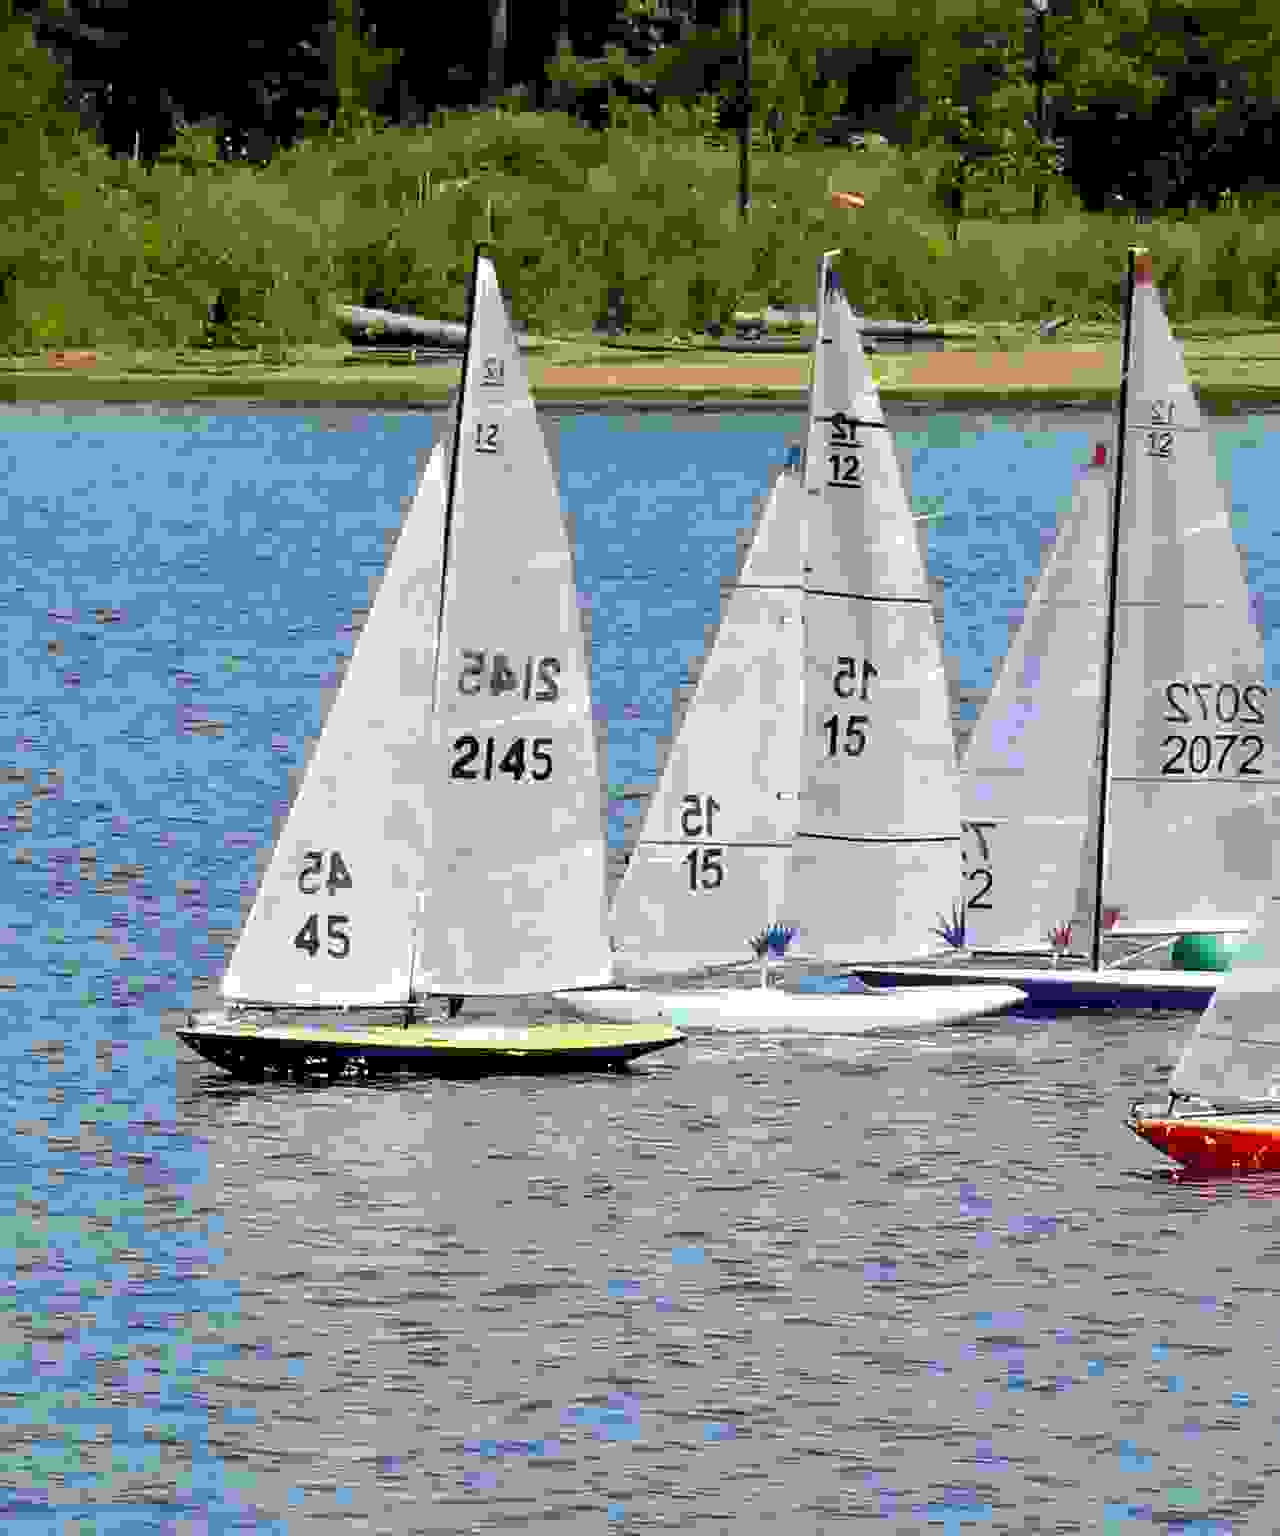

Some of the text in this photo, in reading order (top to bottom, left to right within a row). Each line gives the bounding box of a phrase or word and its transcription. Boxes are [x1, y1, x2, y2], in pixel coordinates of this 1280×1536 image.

[476, 423, 500, 446] 12
[1146, 432, 1176, 453] 12
[827, 455, 861, 481] 12
[823, 713, 871, 758] 15
[1161, 735, 1264, 775] 2072
[450, 735, 553, 782] 2145
[682, 848, 725, 892] 15
[961, 868, 993, 909] 2
[293, 912, 352, 959] 45
